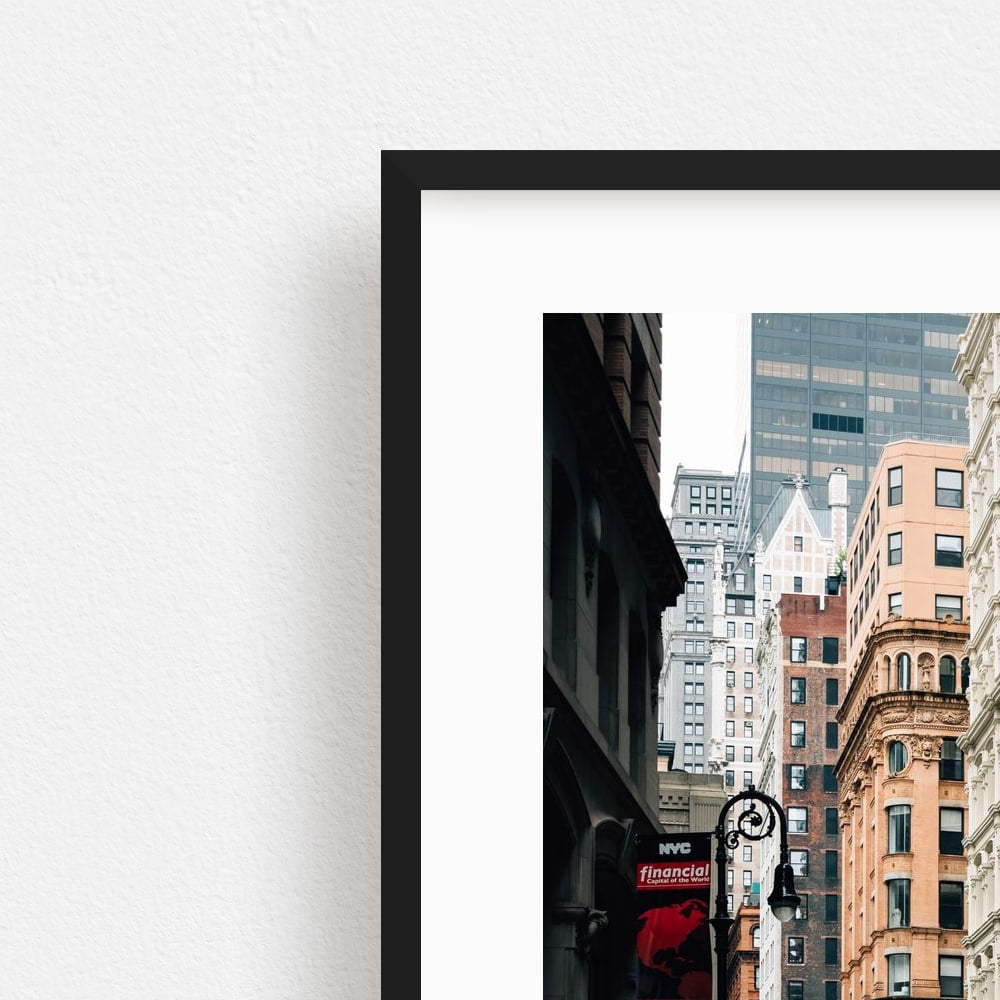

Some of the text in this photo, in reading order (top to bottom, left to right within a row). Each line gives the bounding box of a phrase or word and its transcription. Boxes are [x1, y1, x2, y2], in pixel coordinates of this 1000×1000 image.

[659, 842, 691, 855] NYC
[640, 863, 710, 882] financial
[691, 874, 710, 882] World
